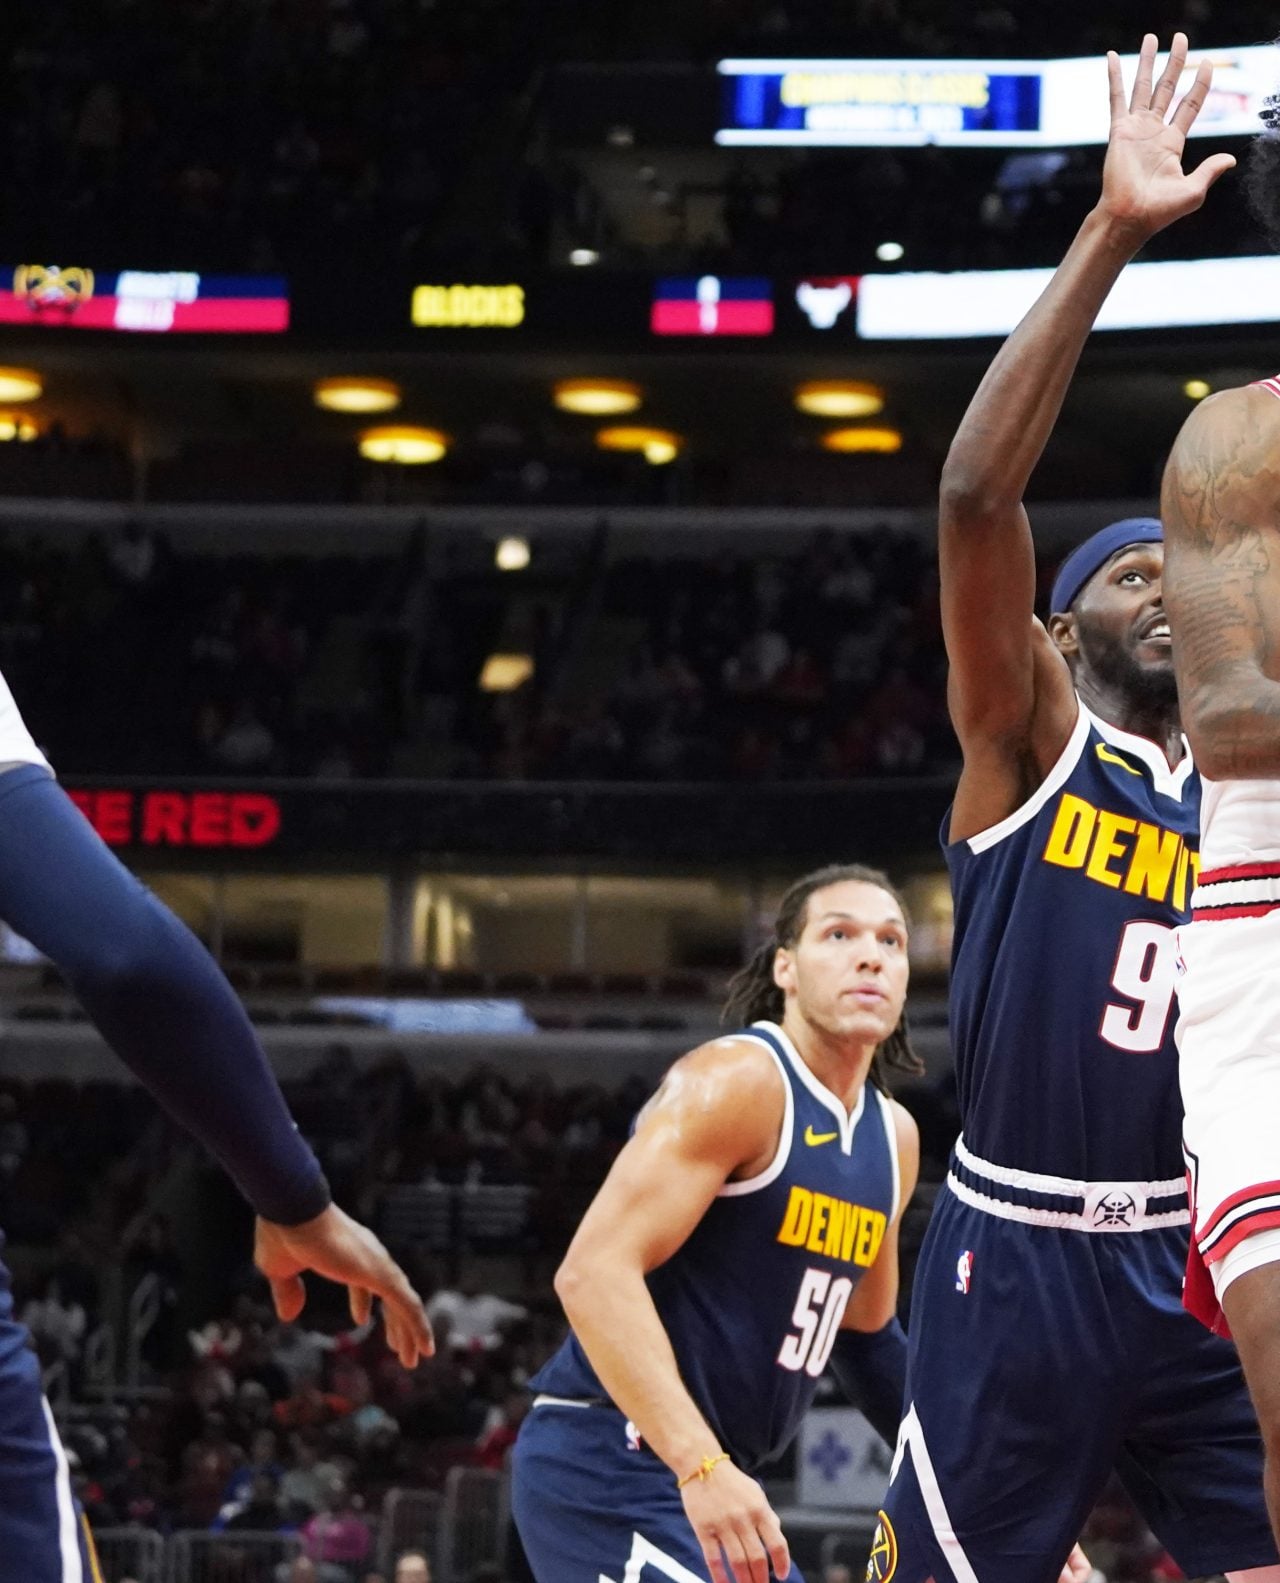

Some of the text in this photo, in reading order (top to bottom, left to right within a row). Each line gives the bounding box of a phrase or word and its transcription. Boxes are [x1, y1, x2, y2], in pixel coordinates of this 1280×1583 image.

[142, 790, 280, 846] RED
[776, 1185, 887, 1268] DENVER
[776, 1267, 853, 1378] 50
